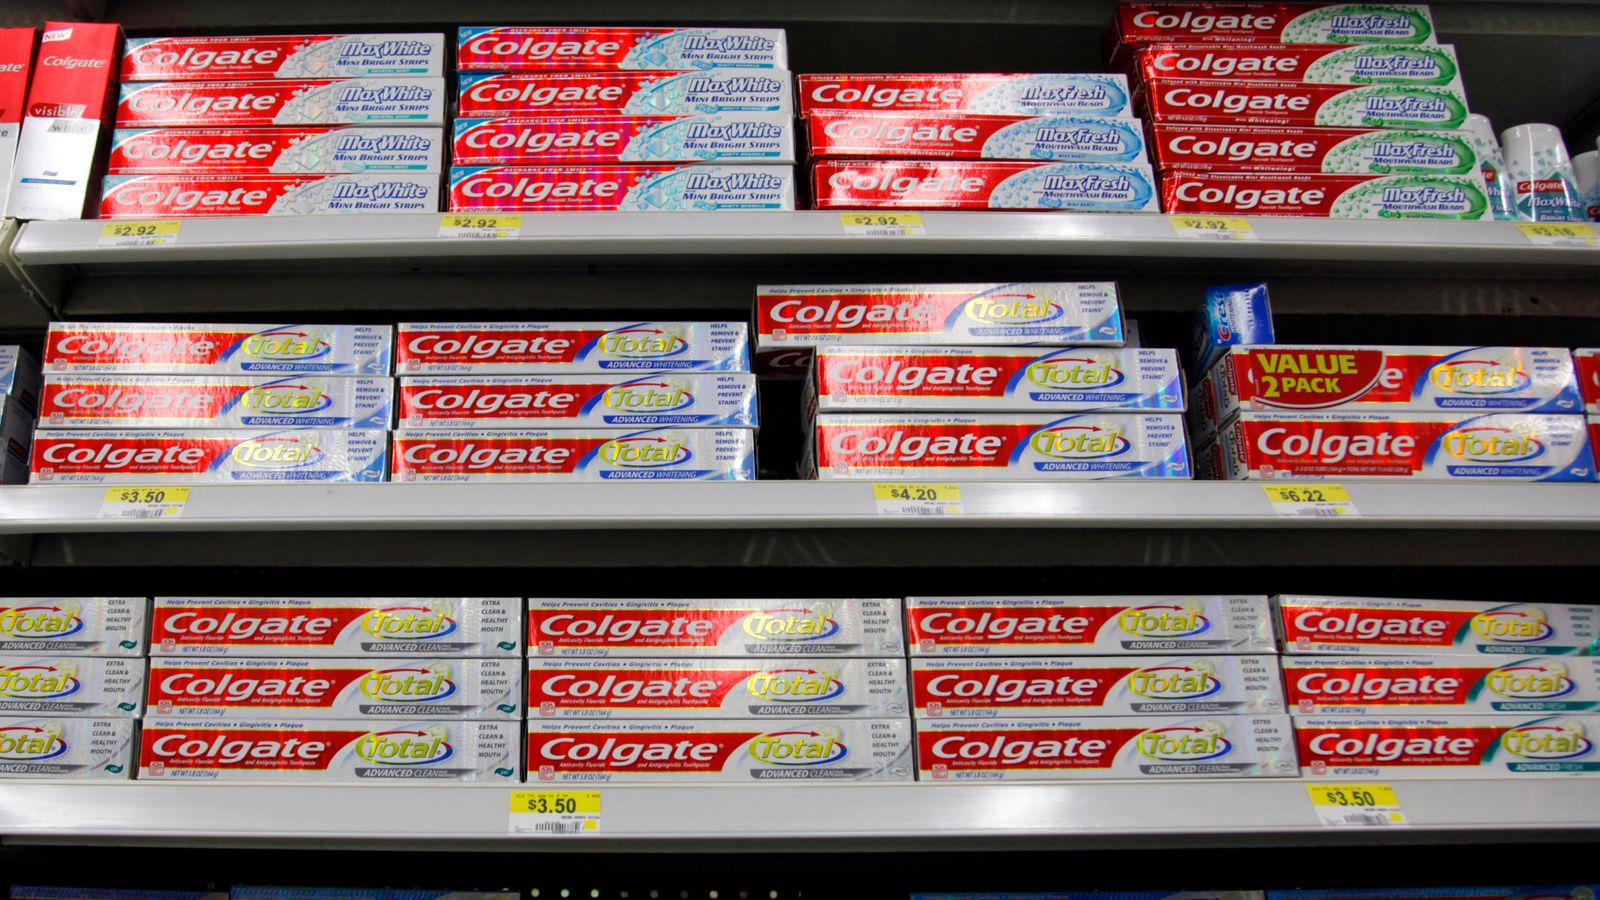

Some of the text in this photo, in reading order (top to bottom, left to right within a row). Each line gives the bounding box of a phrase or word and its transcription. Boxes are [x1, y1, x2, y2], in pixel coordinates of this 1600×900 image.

[1133, 11, 1276, 33] Colgate
[1331, 14, 1411, 30] MaxFresh
[340, 41, 432, 58] MaxWhite
[470, 37, 620, 60] Colgate
[684, 35, 774, 52] MaxWhite
[44, 56, 104, 69] Colgate
[132, 48, 277, 70] Colgate
[1153, 53, 1297, 75] Colgate
[1355, 55, 1435, 71] MaxFresh
[340, 86, 432, 103] MaxWhite
[470, 84, 623, 106] Colgate
[688, 77, 781, 94] MaxWhite
[812, 84, 962, 107] Colgate
[1022, 85, 1106, 104] MaxFresh
[128, 93, 276, 115] Colgate
[1164, 88, 1310, 113] Colgate
[1366, 96, 1446, 112] MaxFresh
[466, 129, 620, 152] Colgate
[687, 122, 781, 141] MaxWhite
[824, 120, 977, 144] Colgate
[1036, 127, 1120, 145] MaxFresh
[122, 140, 272, 163] Colgate
[338, 135, 431, 153] MaxWhite
[1169, 135, 1316, 161] Colgate
[1374, 141, 1455, 159] MaxFresh
[333, 182, 428, 201] MaxWhite
[462, 178, 619, 202] Colgate
[686, 173, 781, 192] MaxWhite
[829, 171, 984, 196] Colgate
[1043, 175, 1130, 192] MaxFresh
[115, 186, 267, 210] Colgate
[1175, 182, 1324, 209] Colgate
[1383, 187, 1465, 205] MaxFresh
[115, 226, 156, 236] $2.92
[454, 219, 496, 228] $2.92
[855, 217, 898, 225] $2.92
[1184, 220, 1228, 229] $2.92
[770, 300, 936, 328] Colgate
[977, 300, 1050, 318] Total
[57, 335, 214, 358] Colgate
[249, 337, 320, 354] Total
[409, 335, 570, 358] Colgate
[609, 335, 676, 352] Total
[1037, 363, 1110, 383] Total
[1256, 354, 1358, 374] VALUE
[831, 361, 997, 391] Colgate
[1443, 367, 1516, 387] Total
[1262, 376, 1342, 397] 2 PACK
[53, 388, 214, 413] Colgate
[251, 390, 321, 408] Total
[412, 390, 574, 413] Colgate
[613, 389, 683, 406] Total
[241, 442, 312, 462] Total
[831, 431, 1001, 461] Colgate
[1041, 432, 1117, 452] Total
[1257, 428, 1415, 463] Colgate
[1456, 434, 1530, 455] Total
[43, 443, 204, 468] Colgate
[405, 444, 570, 468] Colgate
[609, 443, 680, 462] Total
[121, 491, 165, 503] $3.50
[891, 489, 937, 500] $4.20
[1280, 490, 1326, 502] $6.22
[3, 611, 73, 631] Total
[164, 612, 332, 639] Colgate
[372, 614, 444, 633] Total
[540, 615, 712, 641] Colgate
[752, 615, 825, 634] Total
[920, 612, 1088, 639] Colgate
[1126, 611, 1197, 631] Total
[1295, 611, 1446, 639] Colgate
[1482, 617, 1541, 636] Total
[160, 673, 330, 701] Colgate
[369, 676, 444, 695] Total
[542, 675, 717, 702] Colgate
[758, 674, 831, 695] Total
[927, 674, 1097, 702] Colgate
[1135, 673, 1207, 693] Total
[1297, 673, 1458, 700] Colgate
[1497, 673, 1562, 692] Total
[152, 734, 325, 763] Colgate
[365, 738, 441, 757] Total
[541, 738, 718, 766] Colgate
[759, 737, 834, 758] Total
[932, 736, 1106, 764] Colgate
[1145, 734, 1217, 754] Total
[1309, 733, 1474, 761] Colgate
[1510, 732, 1579, 752] Total
[528, 798, 576, 813] $3.50
[1327, 792, 1375, 806] $3.50
